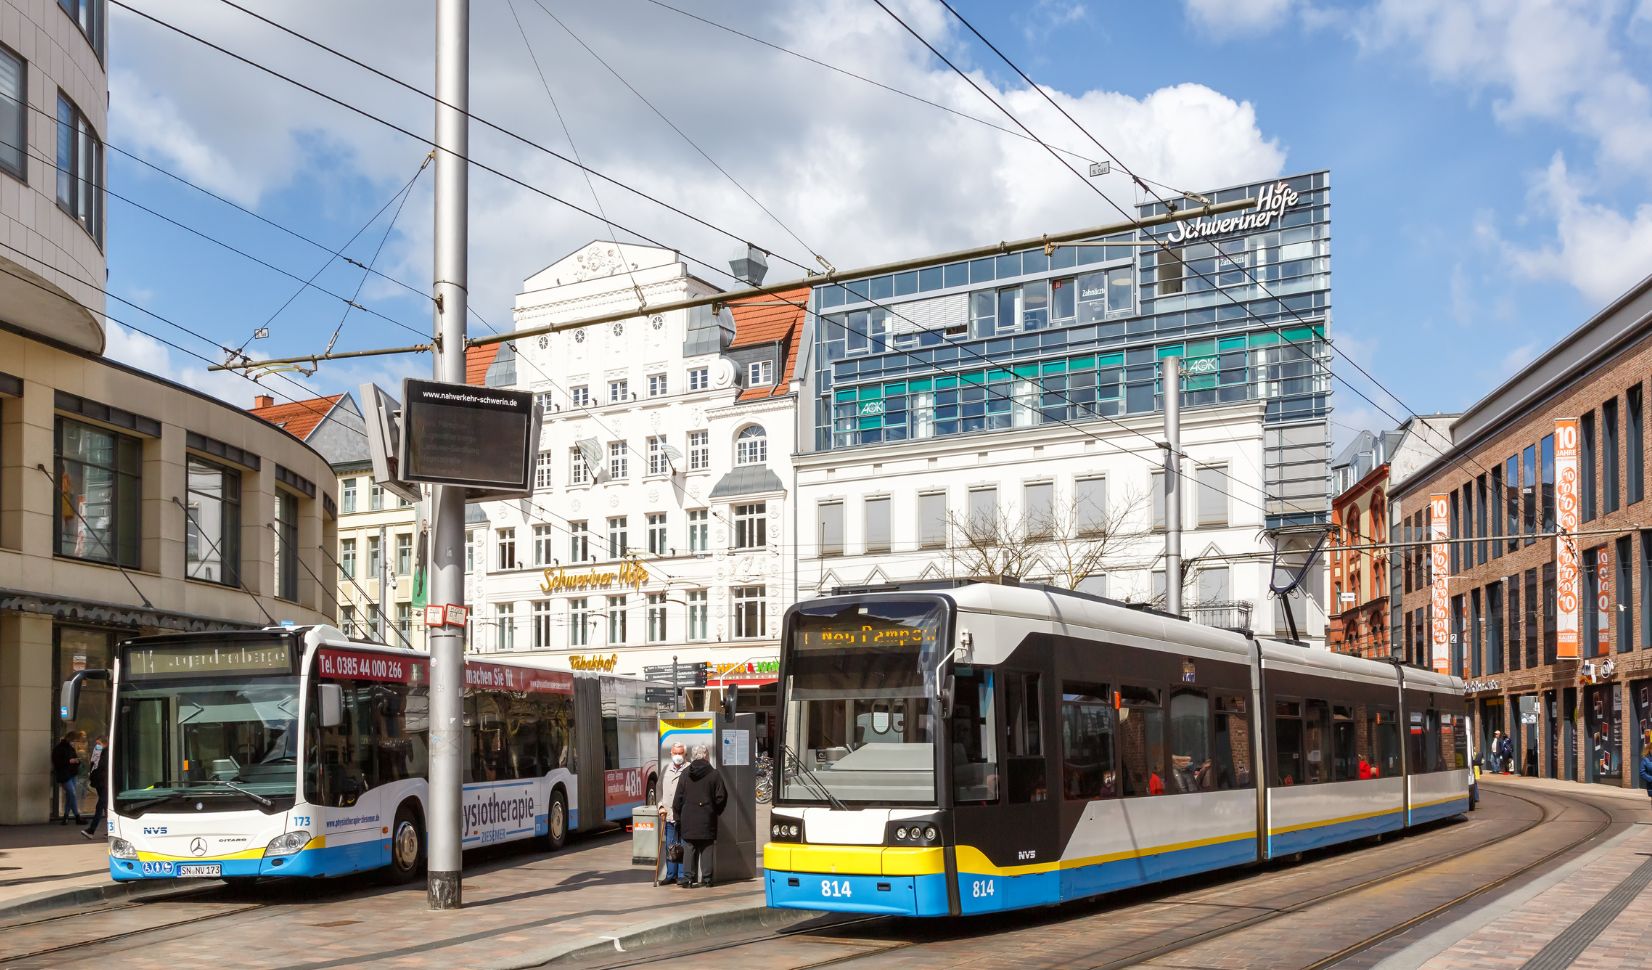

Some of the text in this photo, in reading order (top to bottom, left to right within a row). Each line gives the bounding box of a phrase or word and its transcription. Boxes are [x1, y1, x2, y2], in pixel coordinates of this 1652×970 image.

[1257, 181, 1299, 217] Höfe
[1167, 209, 1279, 243] Schweriner
[1189, 358, 1216, 372] AOK
[423, 391, 518, 406] www.nahverkehr-schwerin.de
[861, 401, 883, 415] AOK
[1555, 426, 1576, 449] 10
[1431, 499, 1448, 518] 10
[320, 654, 402, 679] Tel. 0385 44 000 266
[569, 653, 617, 673] Tabakhof
[465, 668, 492, 685] machen
[493, 669, 505, 687] Sie
[625, 770, 642, 797] 48h
[294, 816, 310, 827] 173
[463, 790, 534, 837] ysiotherapie
[143, 826, 168, 835] NVS
[480, 828, 506, 843] ZIESEMER
[1018, 850, 1036, 860] NVS
[181, 865, 220, 875] SN NV 173
[821, 879, 852, 898] 814
[972, 879, 995, 898] 814
